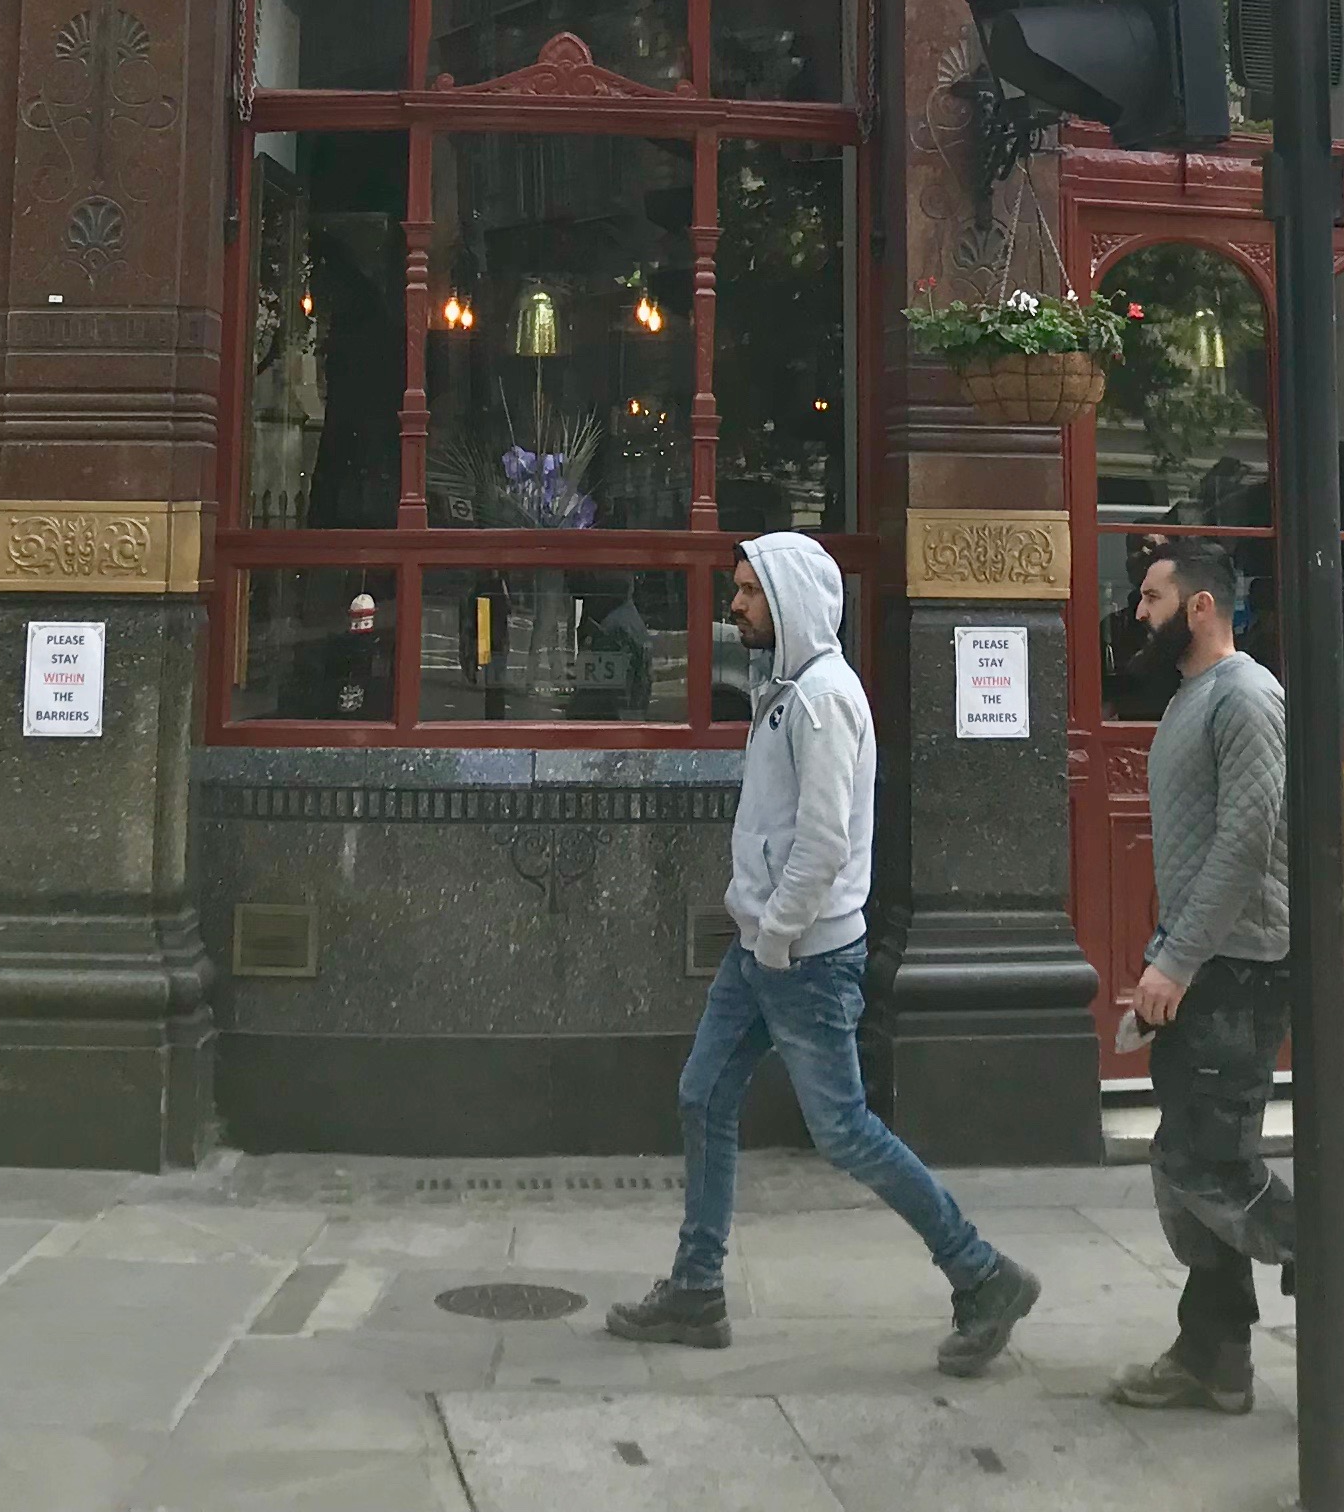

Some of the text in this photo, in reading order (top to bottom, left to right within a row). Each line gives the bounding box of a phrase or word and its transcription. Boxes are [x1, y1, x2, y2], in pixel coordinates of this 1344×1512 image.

[46, 635, 85, 646] PLEASE
[972, 639, 1009, 650] PLEASE
[51, 653, 79, 664] STAY
[978, 657, 1004, 668] STAY
[43, 672, 85, 684] WITHIN
[971, 676, 1011, 686] WITHIN
[52, 691, 74, 702] THE
[982, 694, 1002, 705] THE
[35, 710, 90, 722] BARRIERS
[967, 712, 1018, 723] BARRIERS
